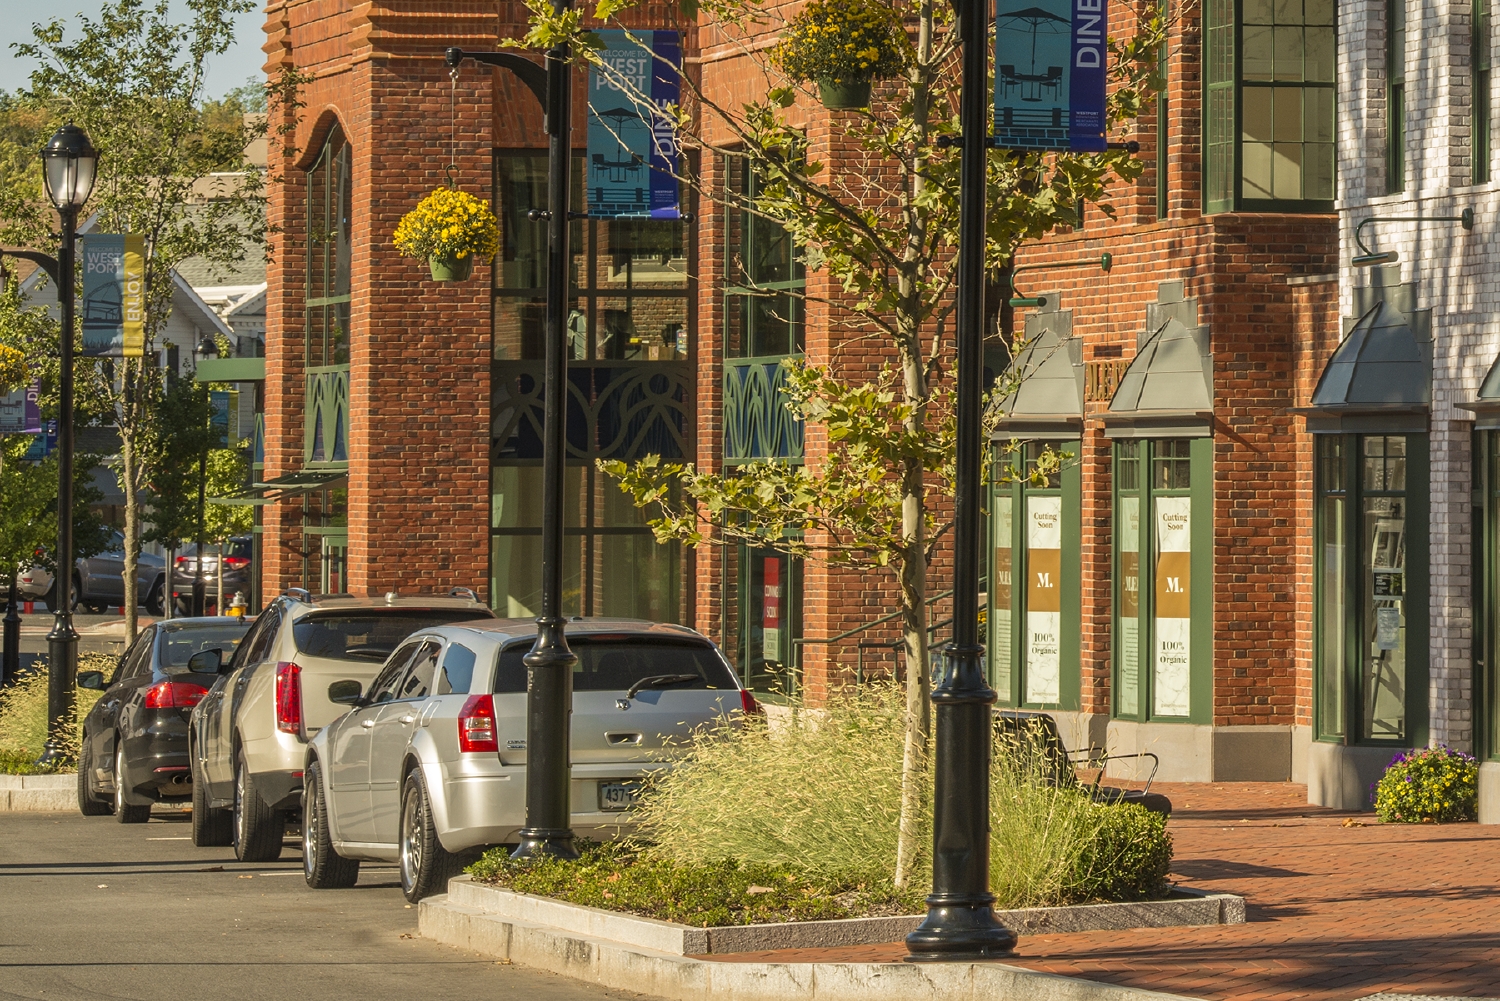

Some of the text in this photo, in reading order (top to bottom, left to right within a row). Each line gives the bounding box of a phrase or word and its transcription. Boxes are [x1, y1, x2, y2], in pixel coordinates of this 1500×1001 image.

[597, 49, 648, 59] WELCOME TO
[654, 99, 675, 156] DINE
[87, 253, 122, 263] WEST
[87, 263, 122, 274] PORT
[127, 272, 140, 321] ENJOY
[1033, 512, 1058, 522] Cutting
[1162, 513, 1188, 523] Cutting
[1167, 522, 1184, 530] Soon
[1036, 572, 1053, 588] M.
[1165, 576, 1184, 593] M.
[1034, 633, 1055, 642] 100%
[1162, 641, 1185, 651] 100%
[1032, 647, 1057, 656] Organic
[1160, 656, 1187, 665] Organic
